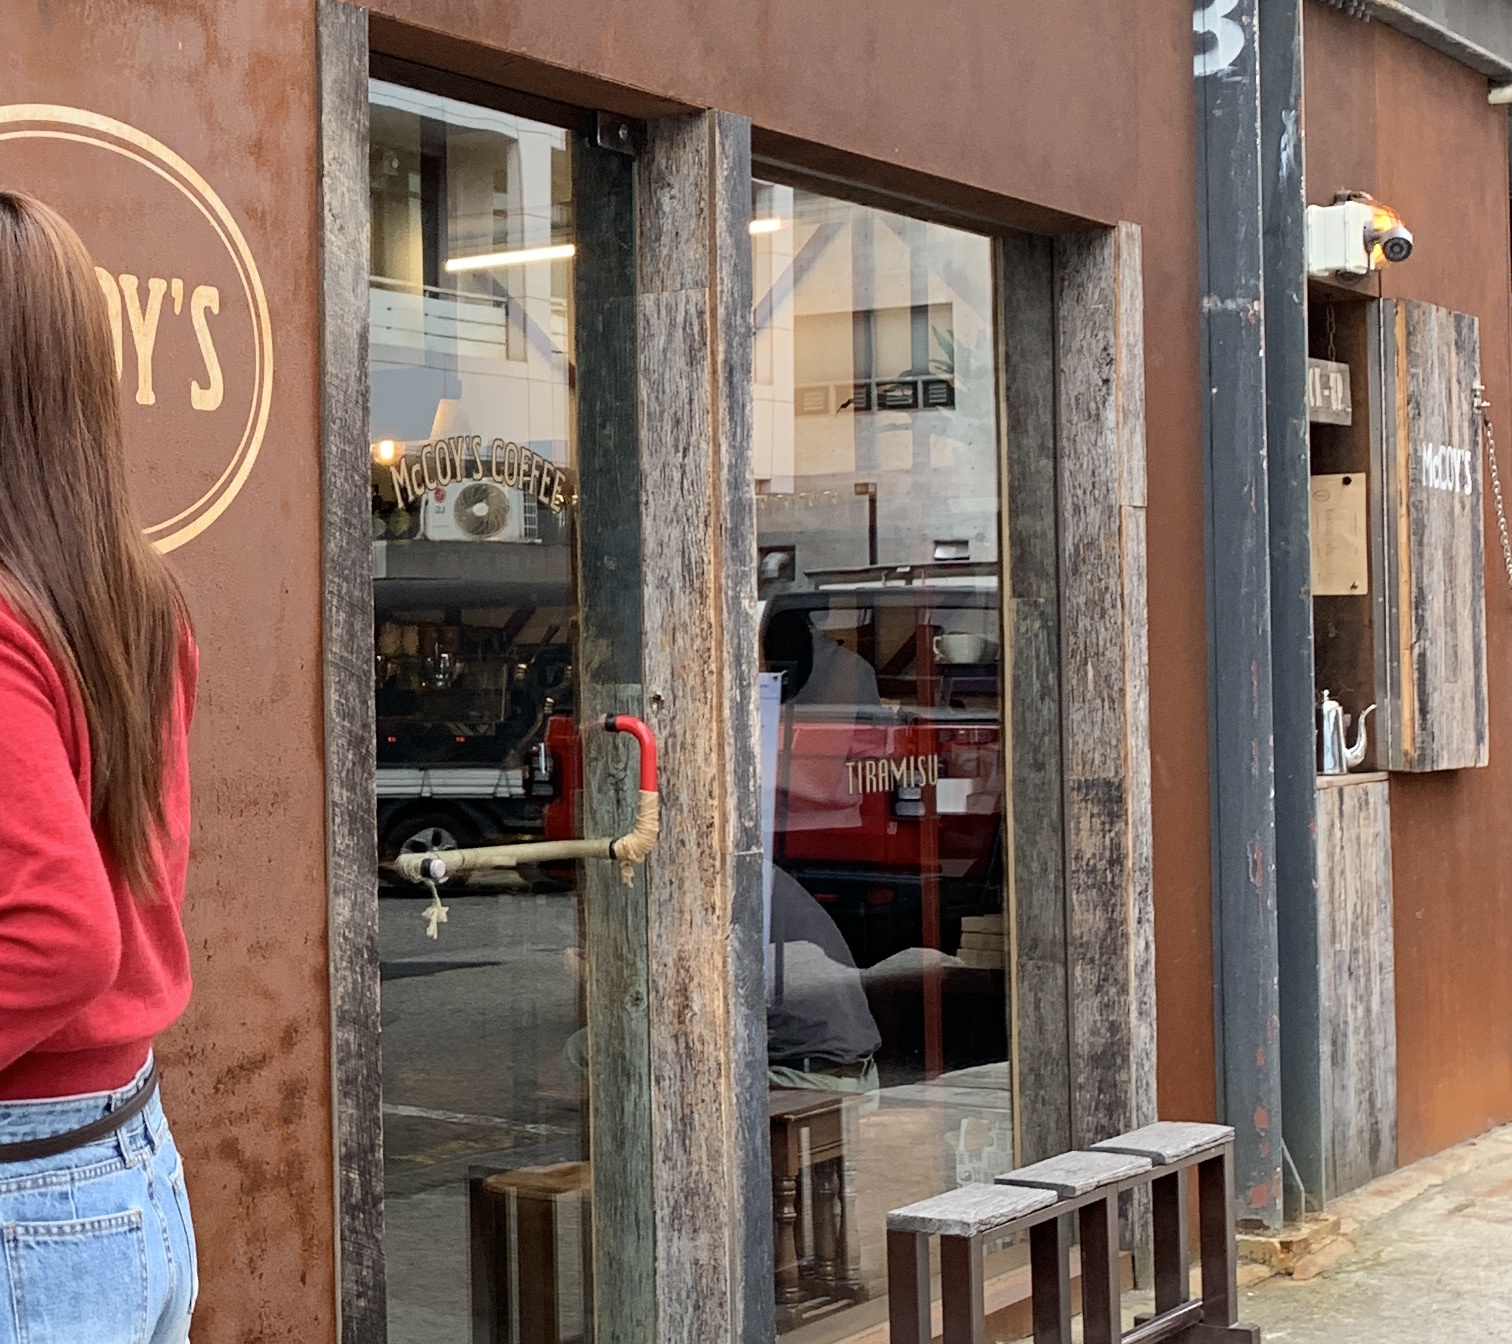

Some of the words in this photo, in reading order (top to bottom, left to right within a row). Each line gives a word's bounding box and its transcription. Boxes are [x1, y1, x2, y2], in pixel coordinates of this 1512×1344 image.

[390, 435, 483, 508] McCOY'S
[491, 437, 566, 514] COFFEE
[1421, 441, 1472, 495] McCOY'S
[845, 754, 938, 795] TIRAMISU
